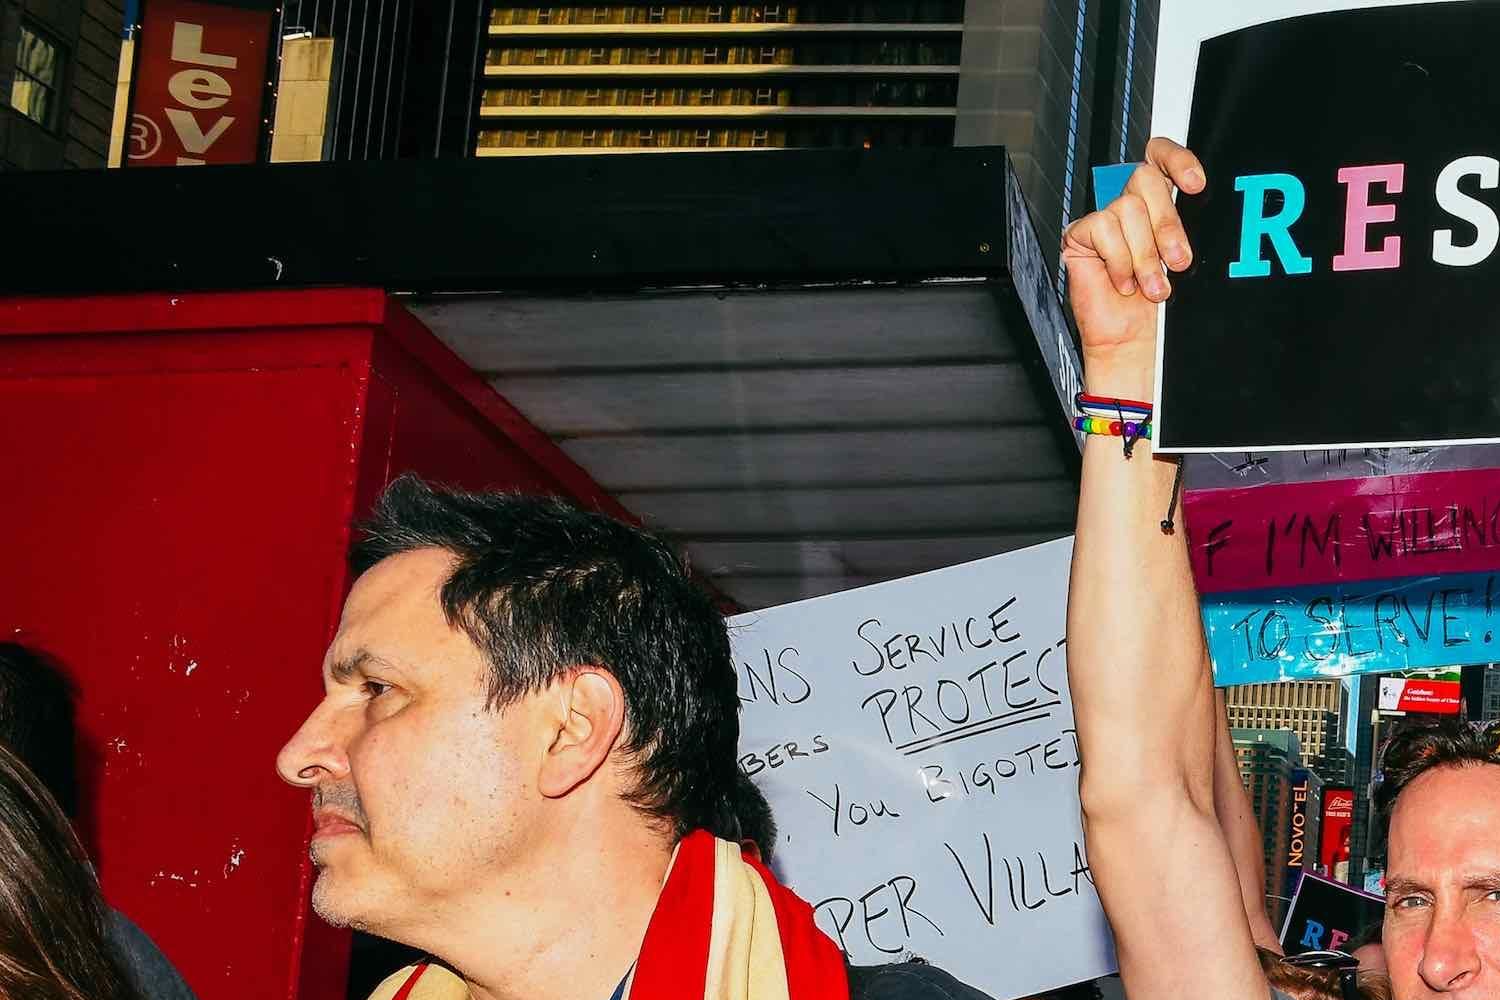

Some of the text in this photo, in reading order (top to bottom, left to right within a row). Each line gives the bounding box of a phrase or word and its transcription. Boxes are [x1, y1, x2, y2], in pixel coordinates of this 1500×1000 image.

[164, 21, 238, 166] Lev
[1263, 512, 1342, 577] I'M
[738, 596, 1021, 706] NS SERVICE
[1232, 606, 1290, 662] TO
[860, 639, 1067, 743] PROTEC
[1287, 780, 1309, 867] NOVOTEL
